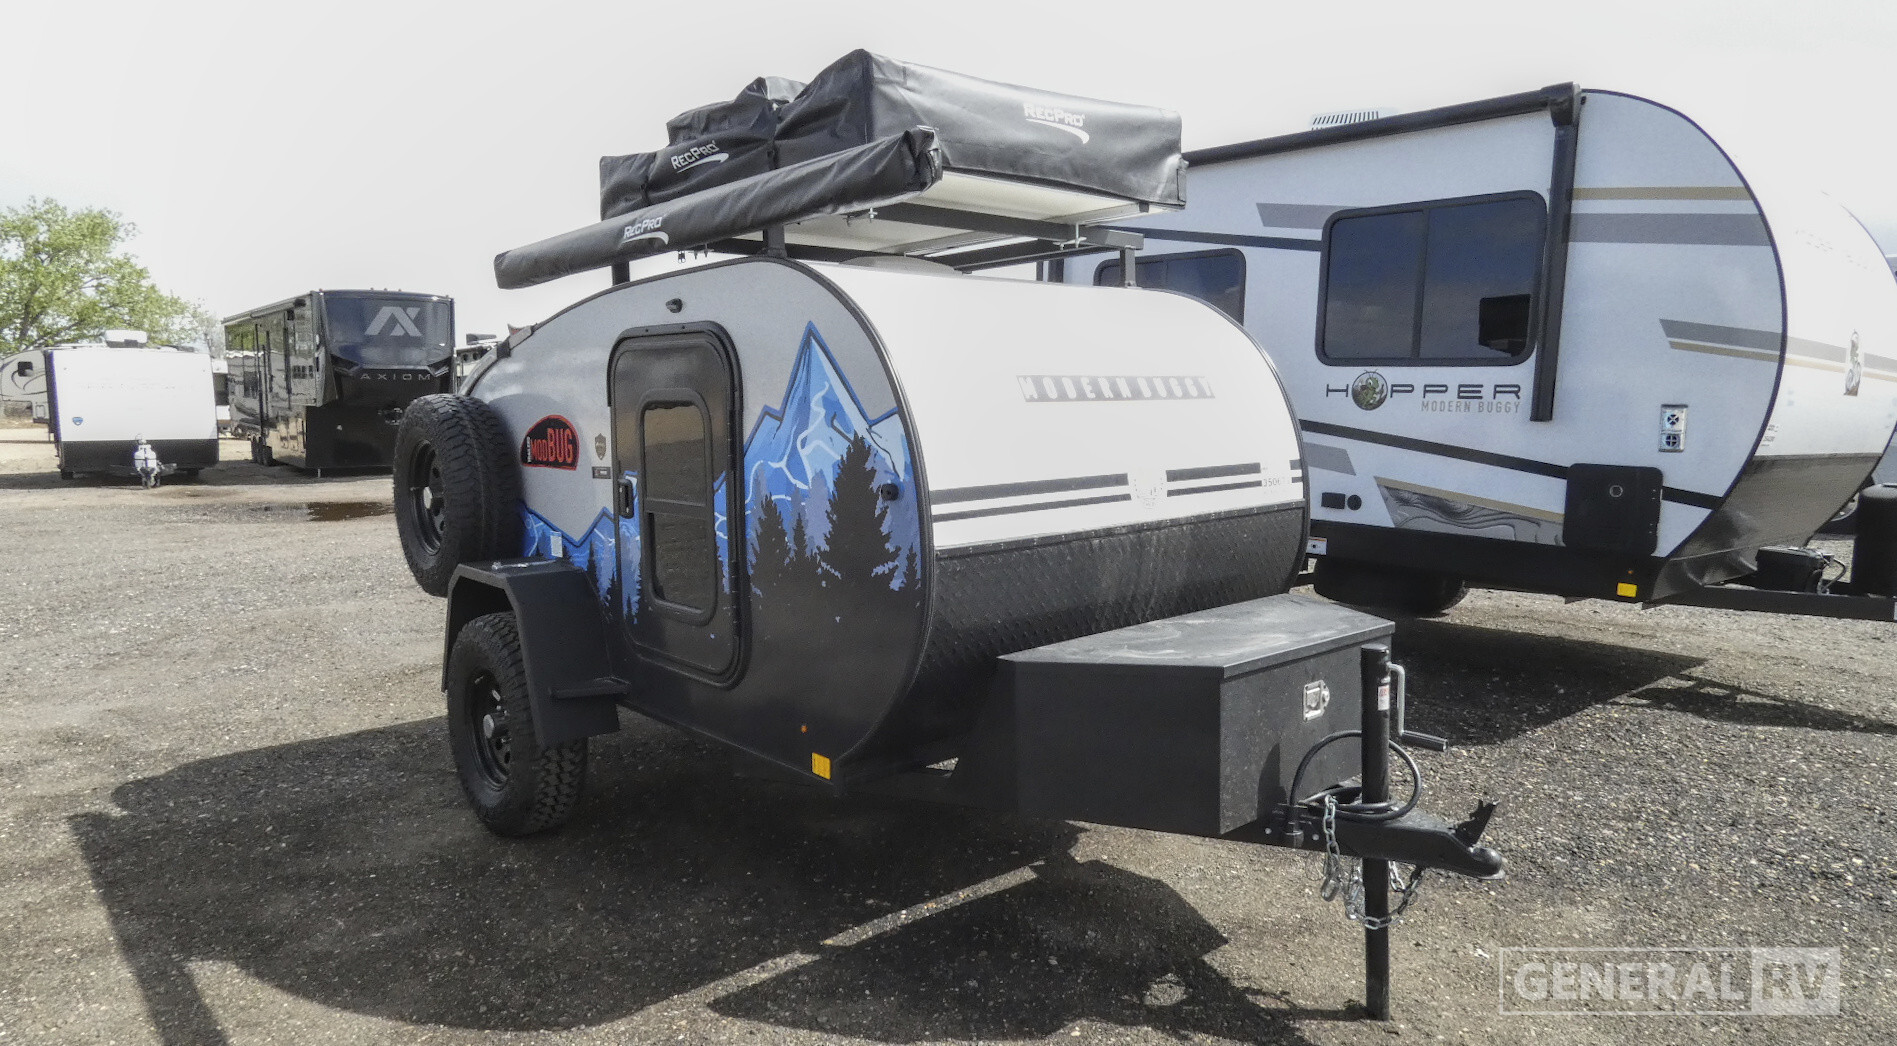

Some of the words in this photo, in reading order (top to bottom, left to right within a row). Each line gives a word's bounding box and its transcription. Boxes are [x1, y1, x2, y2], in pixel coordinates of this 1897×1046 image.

[360, 373, 431, 381] AXIOM
[1326, 371, 1521, 411] HOPPER
[1421, 400, 1471, 413] MODERN
[1477, 401, 1521, 414] BUGGY
